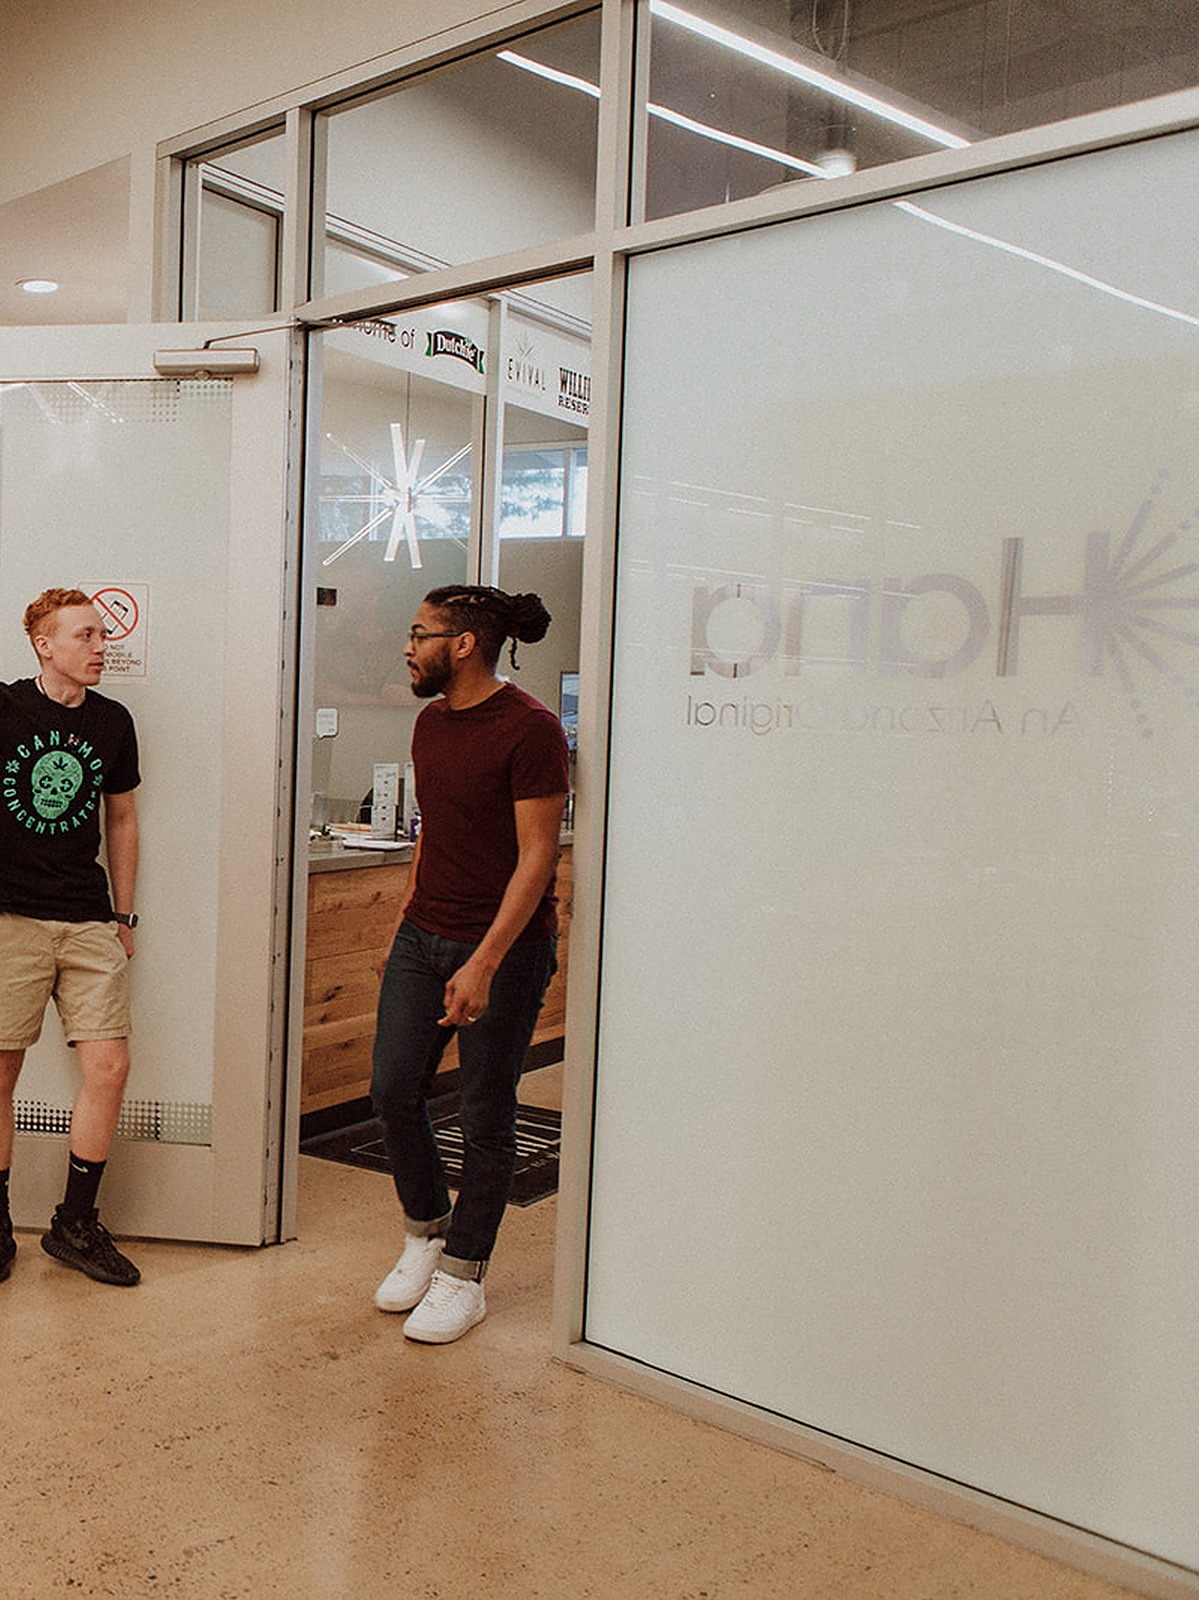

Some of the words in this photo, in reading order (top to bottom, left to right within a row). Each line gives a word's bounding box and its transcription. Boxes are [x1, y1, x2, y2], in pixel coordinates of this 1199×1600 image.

[401, 329, 415, 348] of
[437, 333, 478, 362] Dutchie
[507, 358, 546, 391] EVIVAL
[559, 367, 591, 402] WILLI
[558, 395, 589, 415] RESER
